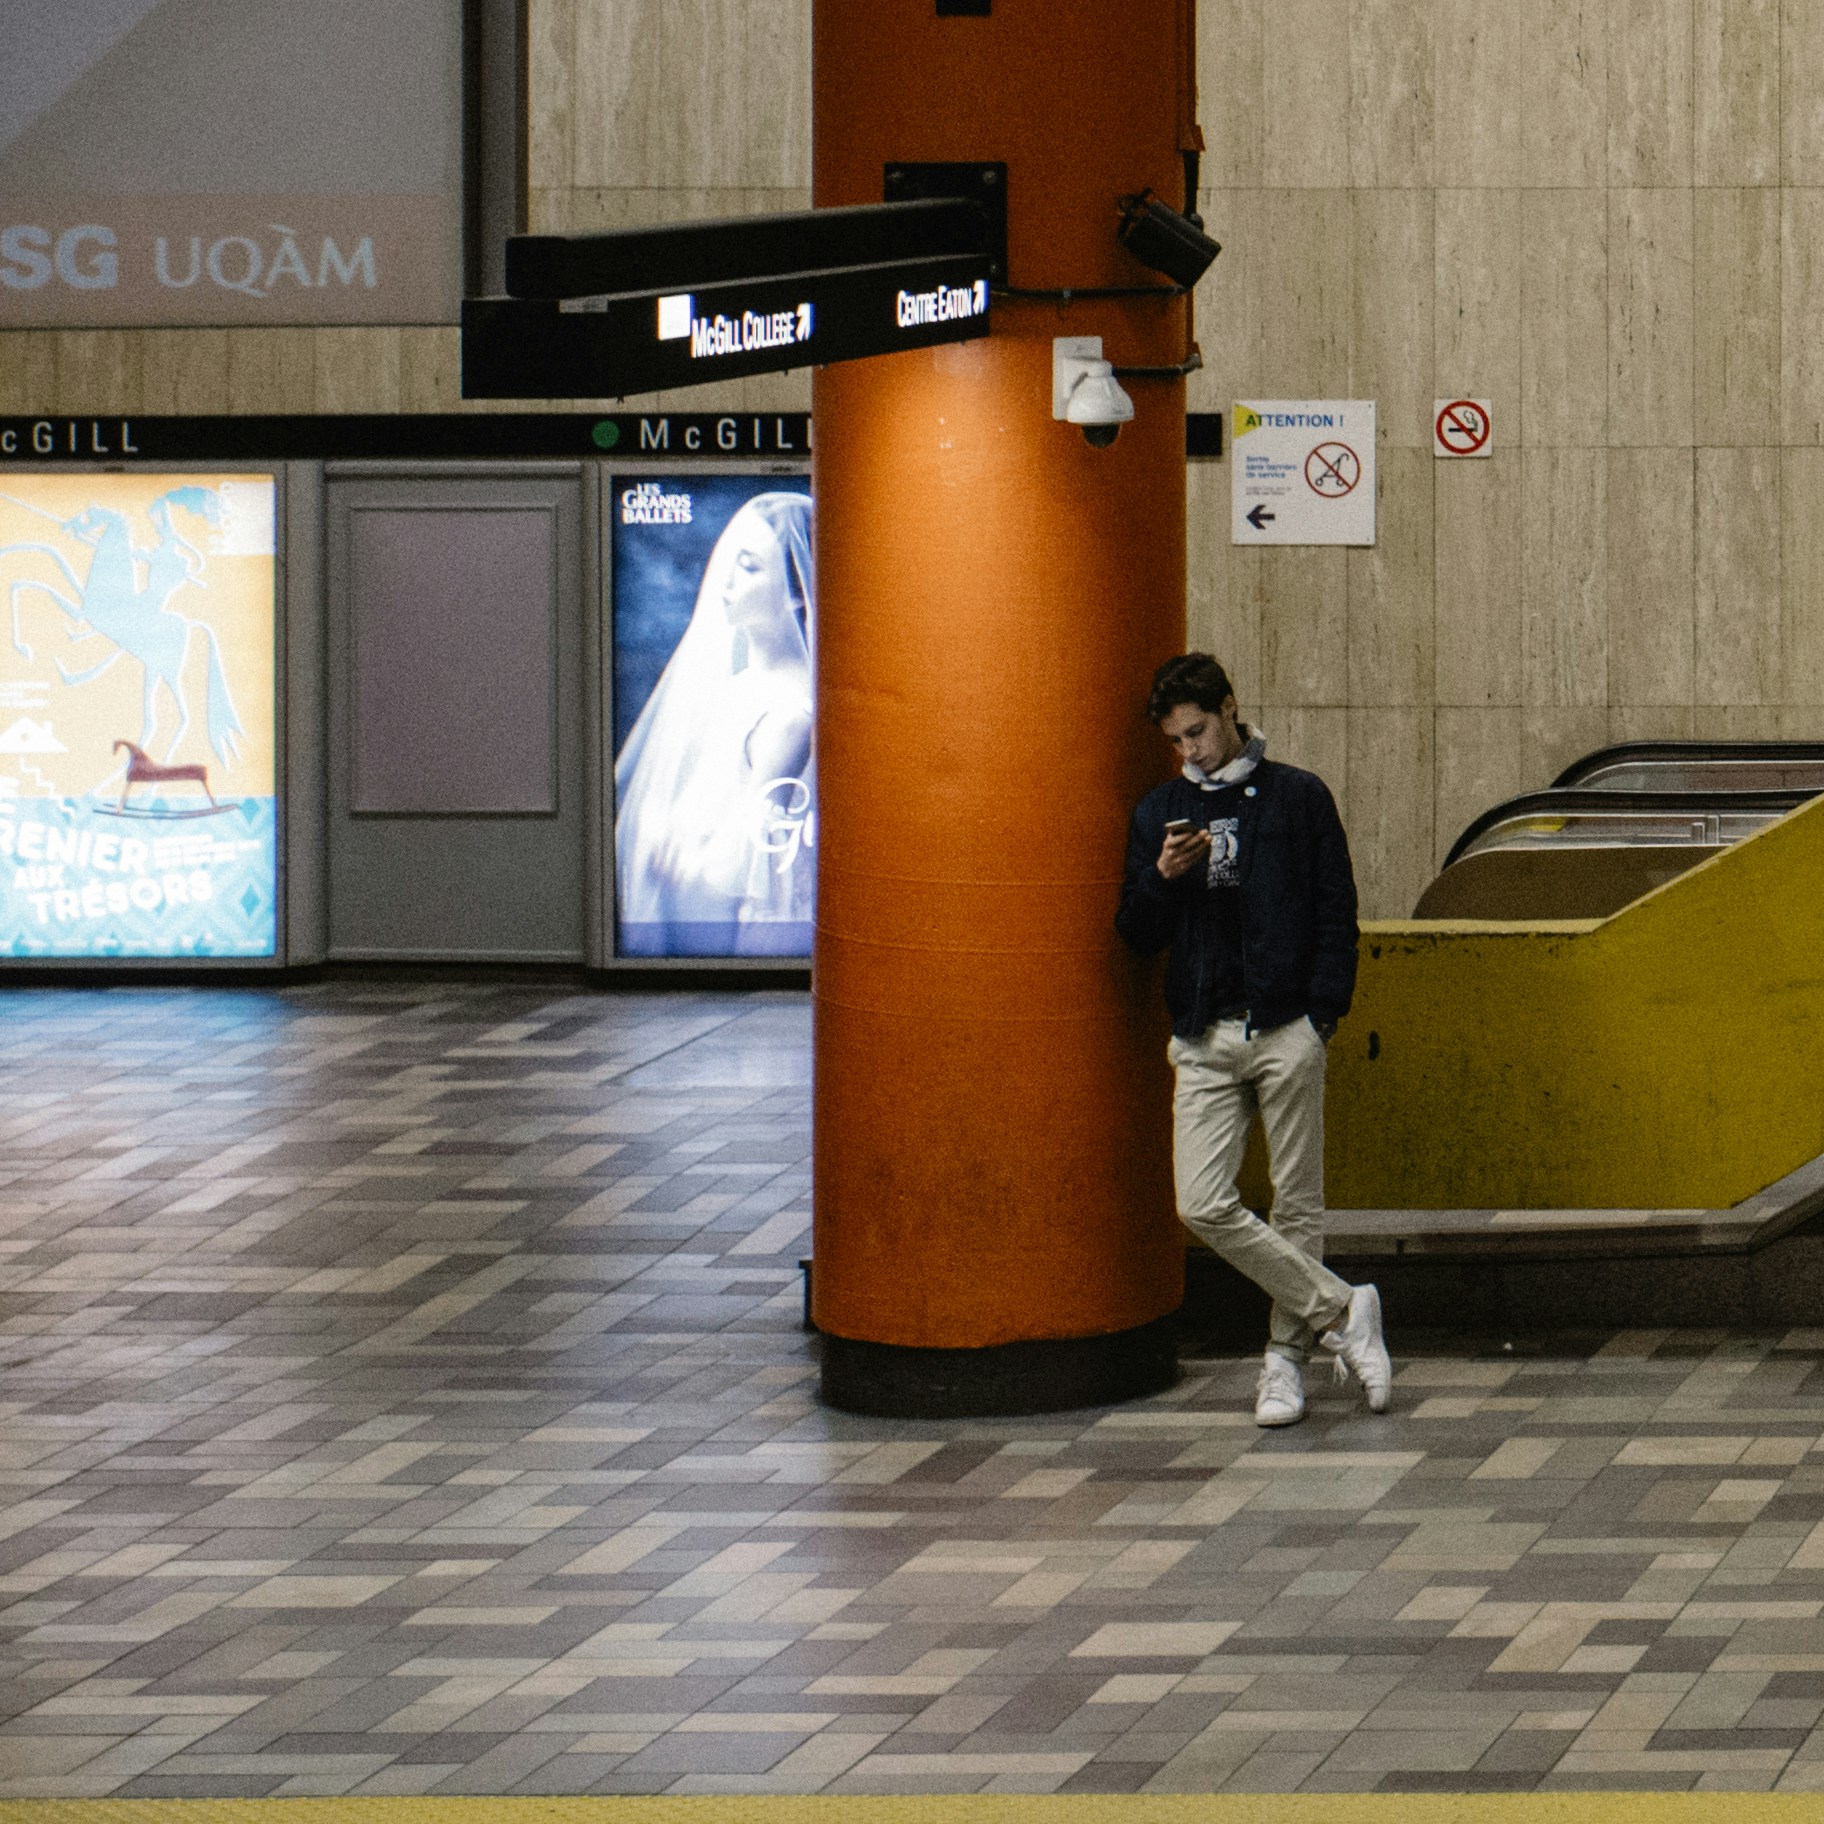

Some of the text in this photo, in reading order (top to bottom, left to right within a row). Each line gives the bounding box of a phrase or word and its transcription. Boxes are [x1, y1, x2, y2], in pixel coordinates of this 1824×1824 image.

[0, 223, 377, 298] SG UQÀM
[897, 285, 972, 328] CENTRE EATON
[742, 310, 796, 351] COLLEGE
[1246, 414, 1334, 428] ATTENTION
[622, 508, 693, 525] BALLETS
[13, 865, 65, 889] AUX
[27, 870, 214, 925] TRÉSORS
